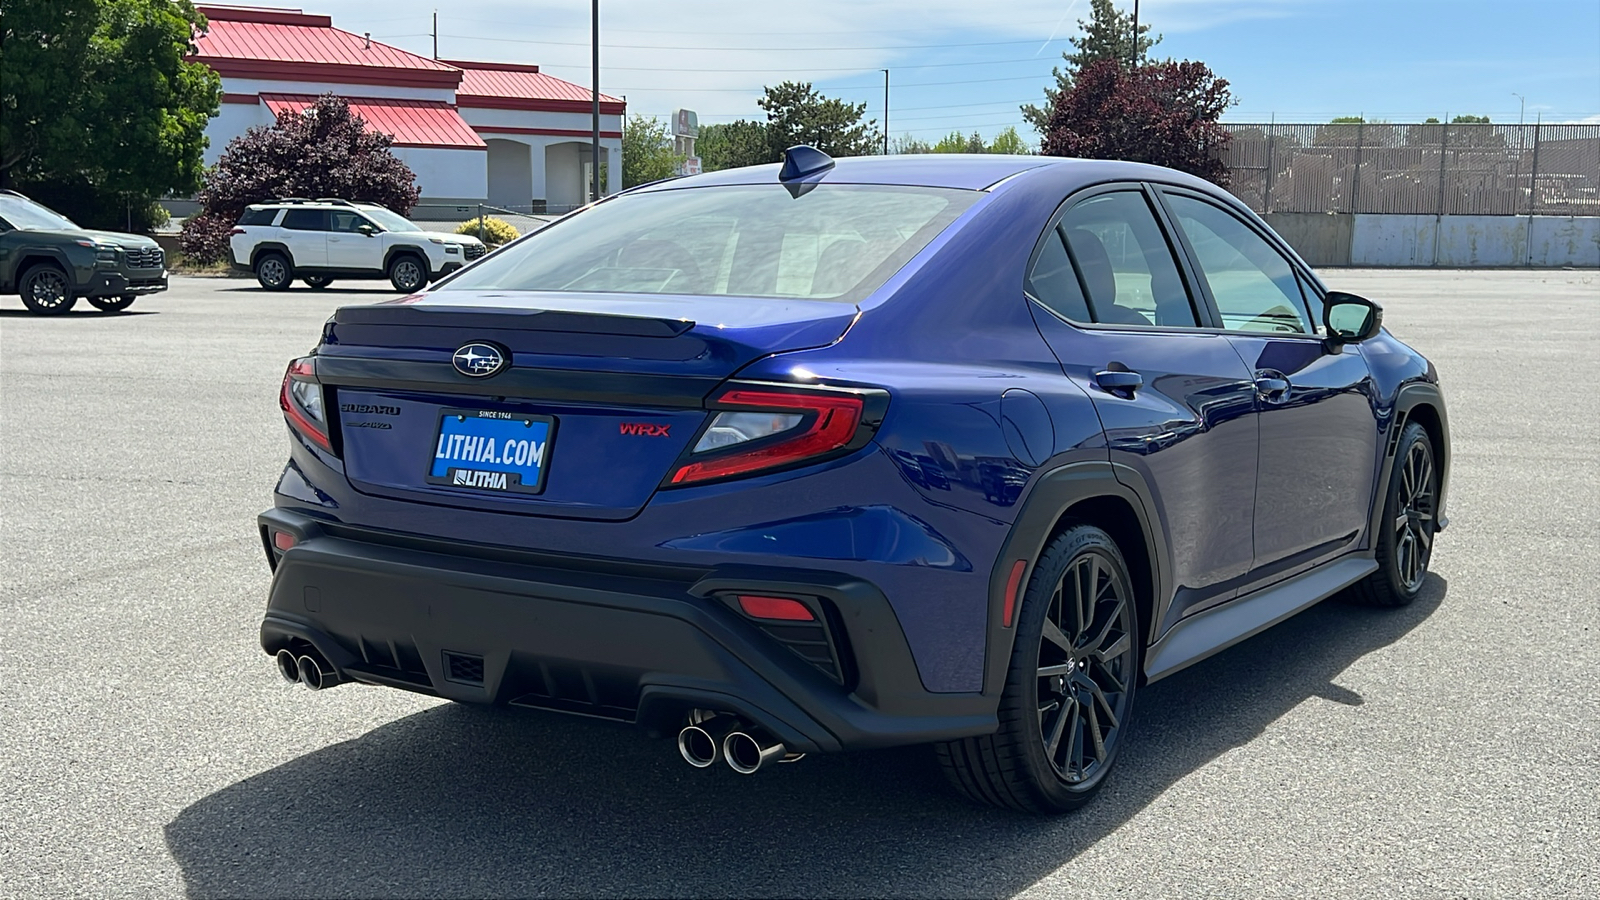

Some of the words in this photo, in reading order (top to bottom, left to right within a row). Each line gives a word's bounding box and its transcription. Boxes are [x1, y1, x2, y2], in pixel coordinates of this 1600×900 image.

[340, 403, 402, 416] SUBARU
[478, 410, 497, 419] SINCE
[498, 411, 512, 420] 1946
[357, 421, 393, 430] AWD
[619, 422, 671, 438] WRX
[435, 433, 546, 468] LITHIA.COM
[465, 470, 507, 490] LITHIA
